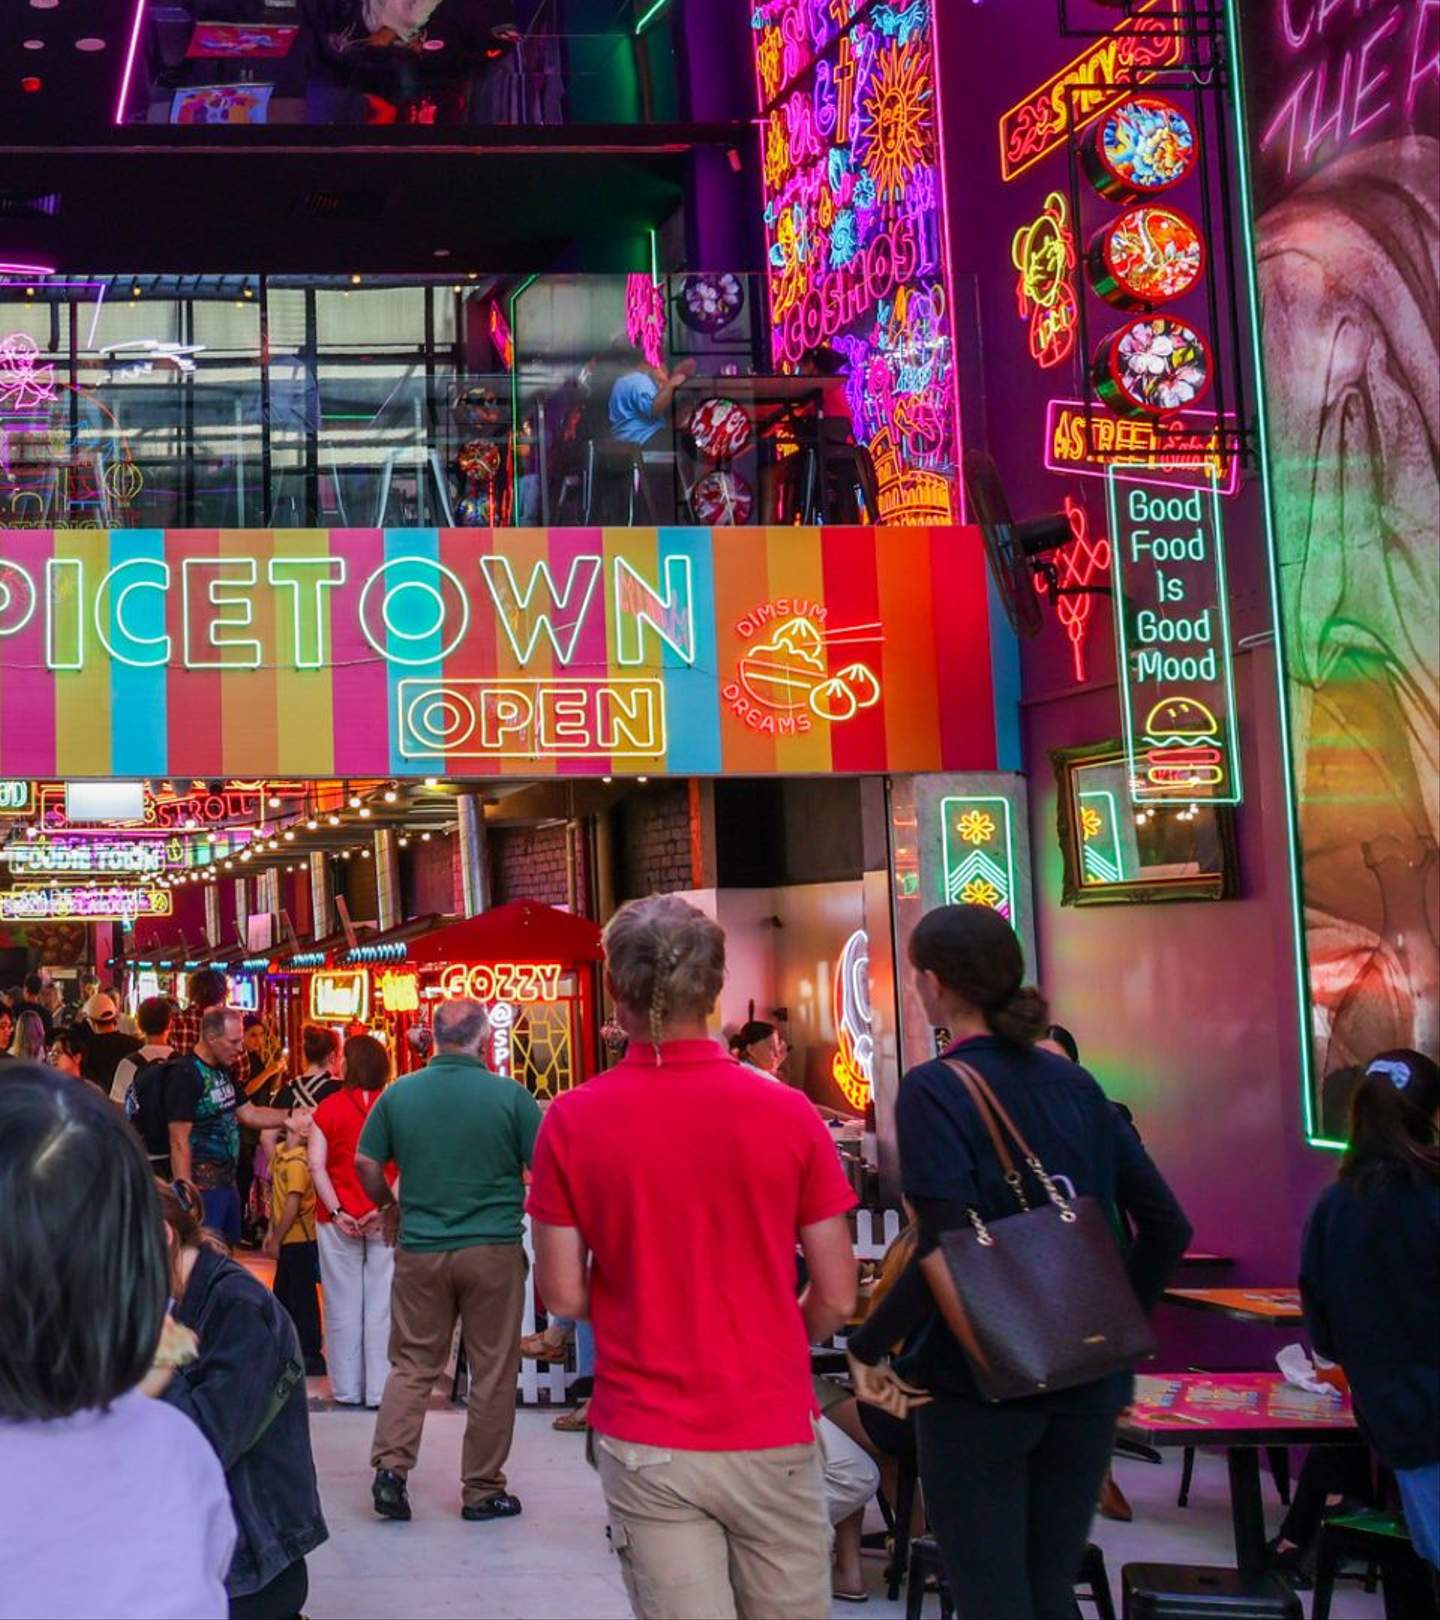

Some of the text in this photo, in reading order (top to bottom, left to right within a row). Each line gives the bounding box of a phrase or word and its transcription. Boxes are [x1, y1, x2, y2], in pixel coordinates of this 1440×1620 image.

[1260, 6, 1399, 176] THE
[1128, 489, 1202, 523] Good
[1131, 528, 1206, 562] Food
[736, 598, 828, 638] DIMSUM
[1137, 608, 1212, 643] Good
[1137, 648, 1217, 683] Mood
[408, 689, 655, 748] OPEN
[722, 683, 811, 734] DREAMS
[158, 793, 254, 827] STROLL
[440, 963, 562, 1001] GOZZY
